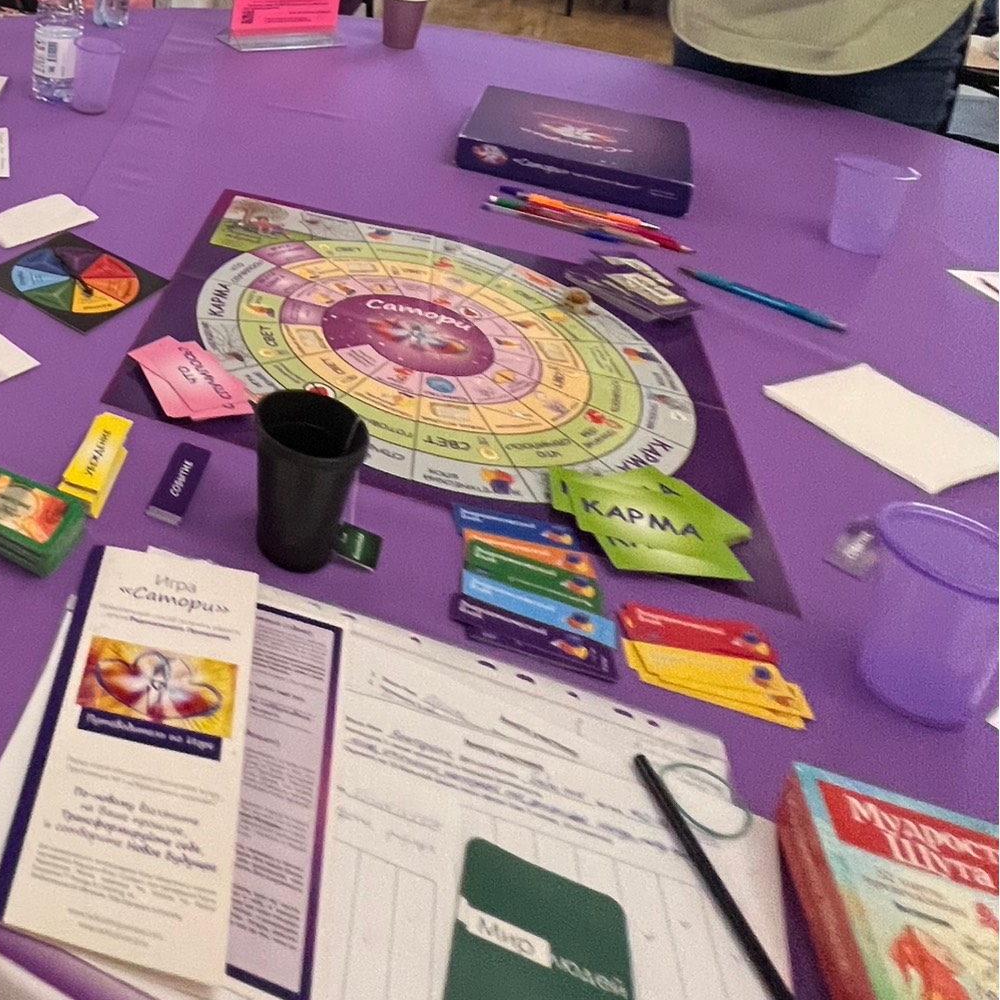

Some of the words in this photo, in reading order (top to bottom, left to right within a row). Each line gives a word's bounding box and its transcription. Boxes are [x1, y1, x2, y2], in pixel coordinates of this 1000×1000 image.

[208, 282, 231, 318] КАРМА
[366, 299, 472, 332] Сатори
[259, 325, 279, 348] СВЕТ
[178, 365, 197, 385] ЧТО
[424, 435, 471, 451] СВЕТ
[169, 459, 194, 498] СОБЫТИЕ
[582, 497, 704, 542] КАРМА
[155, 573, 198, 594] Игра
[119, 586, 231, 616] «Сатори»
[884, 831, 998, 889] Шута
